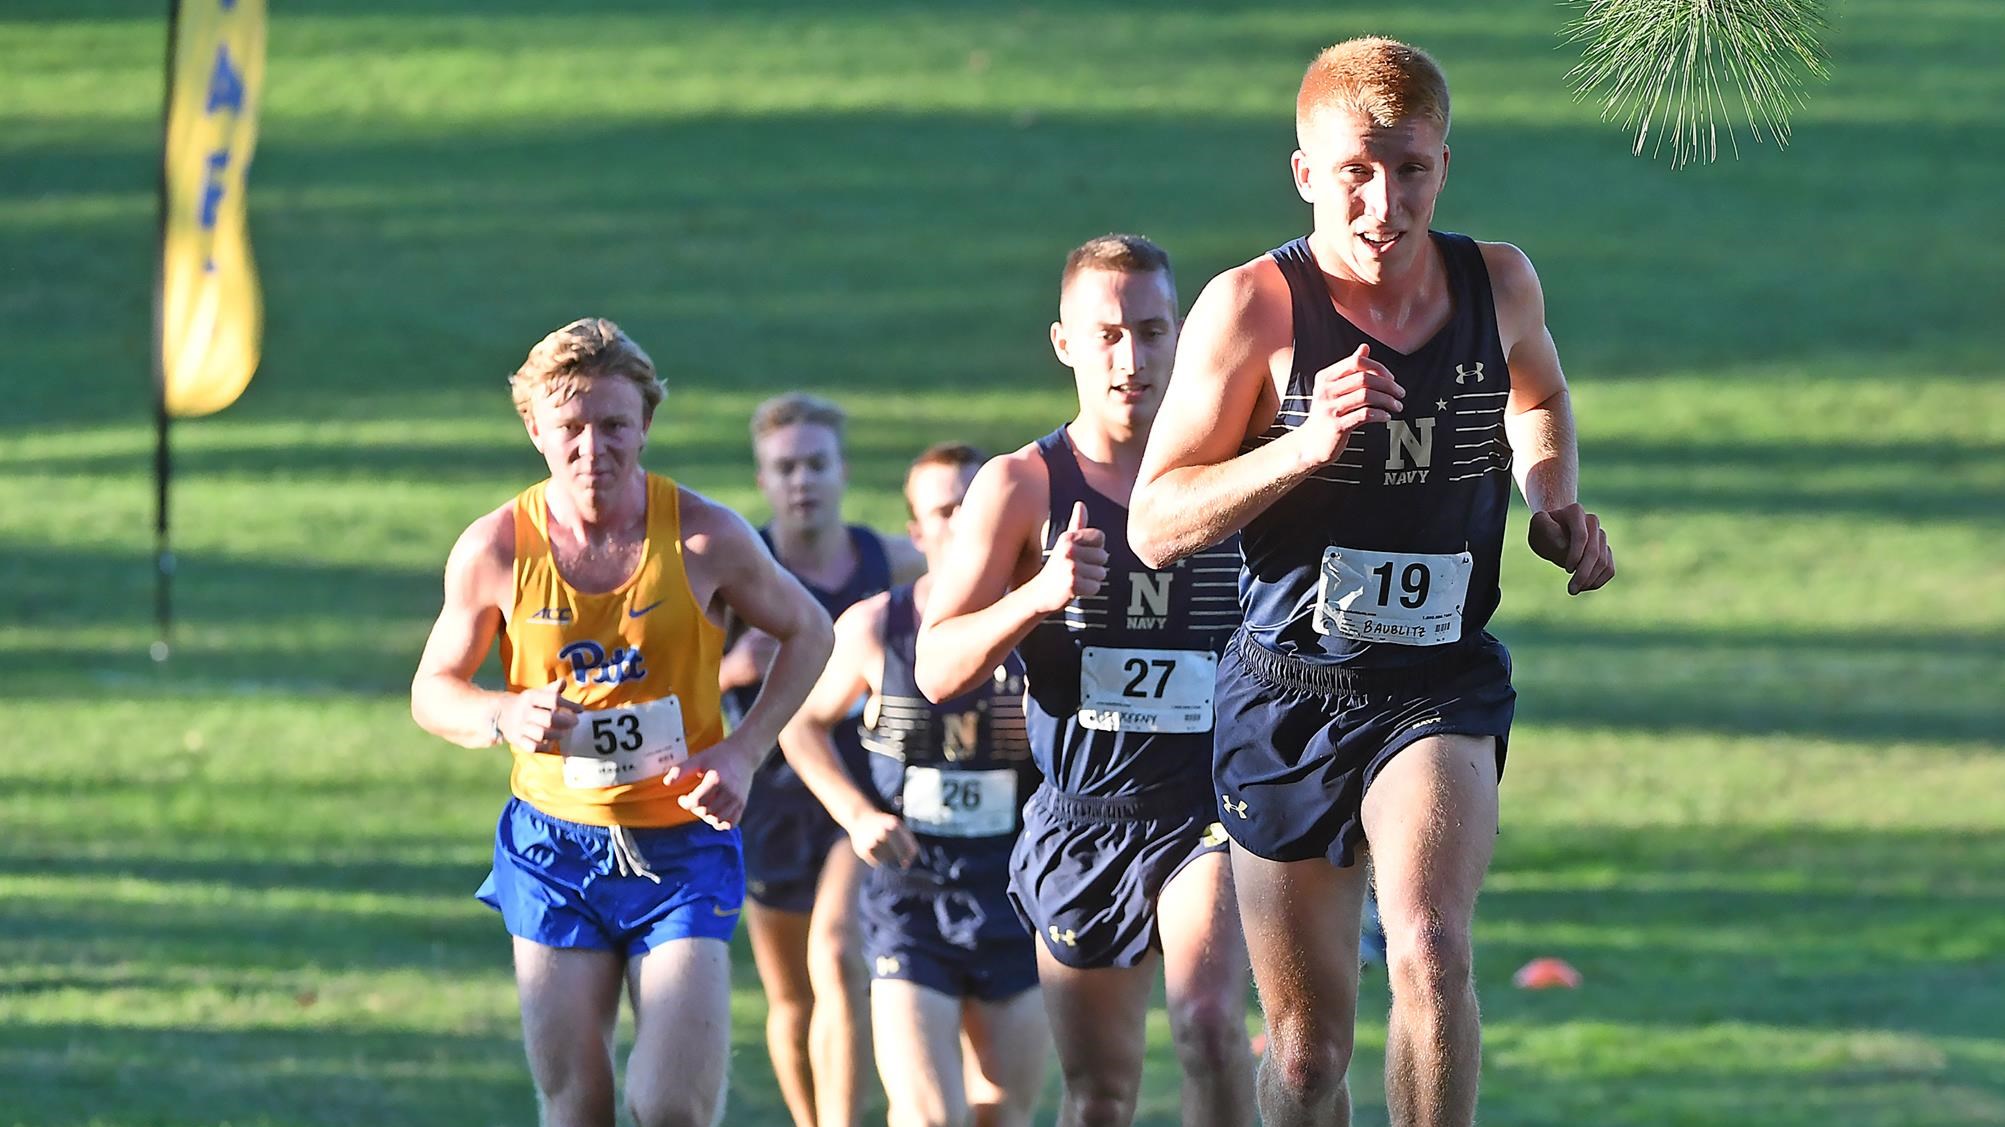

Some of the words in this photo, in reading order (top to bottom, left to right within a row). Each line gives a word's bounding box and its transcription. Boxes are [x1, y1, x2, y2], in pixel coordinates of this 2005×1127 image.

[1385, 417, 1436, 470] N
[1383, 470, 1430, 486] NAVY
[1126, 572, 1174, 616] N
[1373, 561, 1431, 609] 19
[532, 607, 572, 621] ACC
[1126, 617, 1167, 630] NAVY
[1363, 619, 1426, 638] BAUBLITZ
[557, 639, 648, 687] Pitt
[1122, 658, 1176, 698] 27
[592, 714, 643, 755] 53
[942, 780, 982, 811] 26
